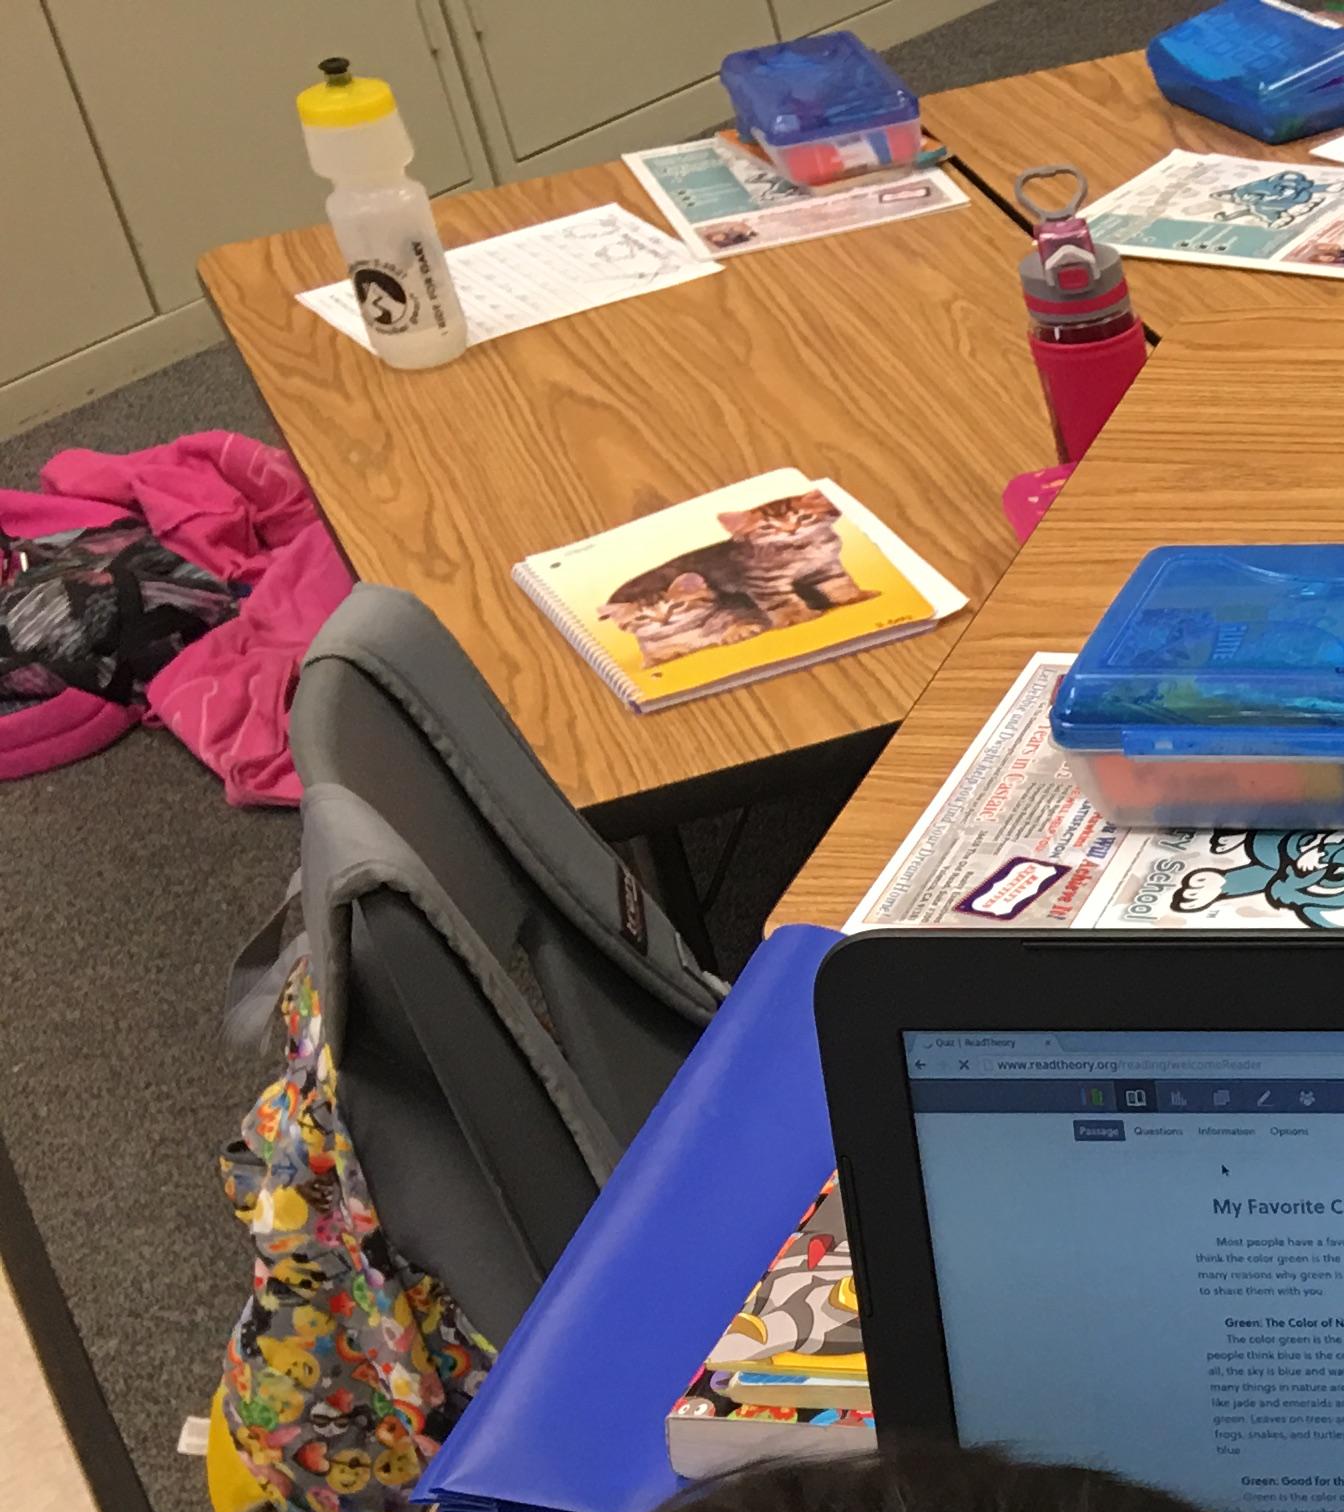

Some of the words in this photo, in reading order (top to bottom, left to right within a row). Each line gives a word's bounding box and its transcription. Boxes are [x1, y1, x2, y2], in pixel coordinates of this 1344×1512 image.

[1089, 837, 1119, 858] Will
[1056, 859, 1095, 905] Achieve
[1126, 859, 1183, 921] School
[1046, 905, 1071, 920] It!
[1134, 1126, 1184, 1137] Questions
[1199, 1126, 1255, 1136] Information
[1269, 1126, 1309, 1138] Options
[1213, 1199, 1242, 1218] My
[1248, 1198, 1325, 1215] Favorite
[1216, 1238, 1243, 1247] Most
[1247, 1238, 1284, 1249] people
[1288, 1238, 1313, 1247] have
[1317, 1239, 1323, 1247] a
[1196, 1254, 1225, 1263] think
[1226, 1254, 1244, 1263] the
[1247, 1254, 1274, 1263] color
[1277, 1255, 1309, 1266] green
[1312, 1255, 1320, 1263] is
[1323, 1254, 1341, 1263] the
[1198, 1271, 1227, 1282] many
[1231, 1272, 1272, 1280] reasons
[1276, 1271, 1297, 1282] why
[1266, 1318, 1285, 1328] The
[1288, 1318, 1318, 1328] Color
[1321, 1318, 1332, 1328] of
[1226, 1335, 1246, 1345] The
[1249, 1335, 1276, 1345] color
[1279, 1337, 1310, 1347] green
[1314, 1335, 1322, 1345] is
[1324, 1335, 1342, 1345] the
[1281, 1476, 1312, 1486] Good
[1315, 1476, 1330, 1486] for
